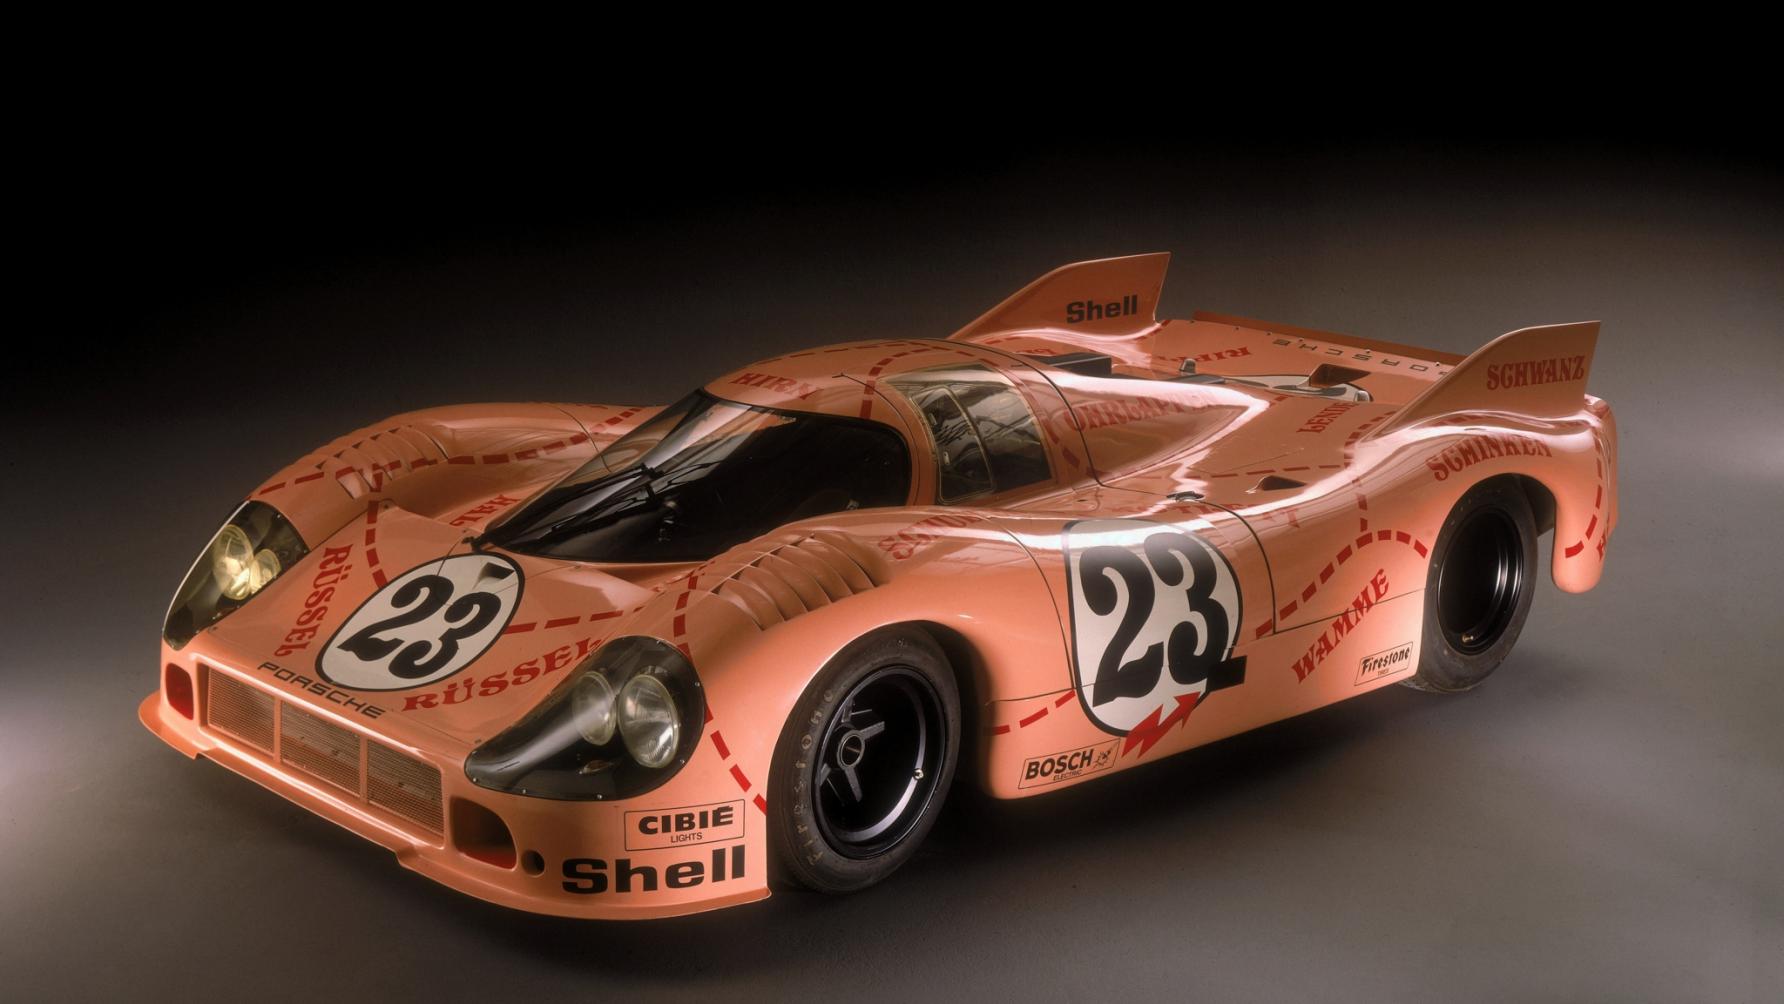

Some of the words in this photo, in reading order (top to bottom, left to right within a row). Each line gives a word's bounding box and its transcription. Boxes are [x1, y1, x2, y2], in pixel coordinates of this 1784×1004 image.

[1066, 295, 1138, 323] Shell
[1486, 355, 1585, 390] SCHWANZ
[1426, 435, 1552, 481] SCHINKEN
[274, 543, 353, 658] RÜSSEL
[1079, 532, 1229, 707] 23
[337, 575, 502, 679] 23
[1291, 568, 1390, 685] WAMME
[402, 636, 603, 713] RÜSSEL
[1361, 647, 1410, 677] Firestone
[257, 662, 386, 719] PORSCHE
[1025, 749, 1094, 780] BOSCH
[670, 832, 702, 844] LIGHTS
[561, 844, 745, 894] Shell
